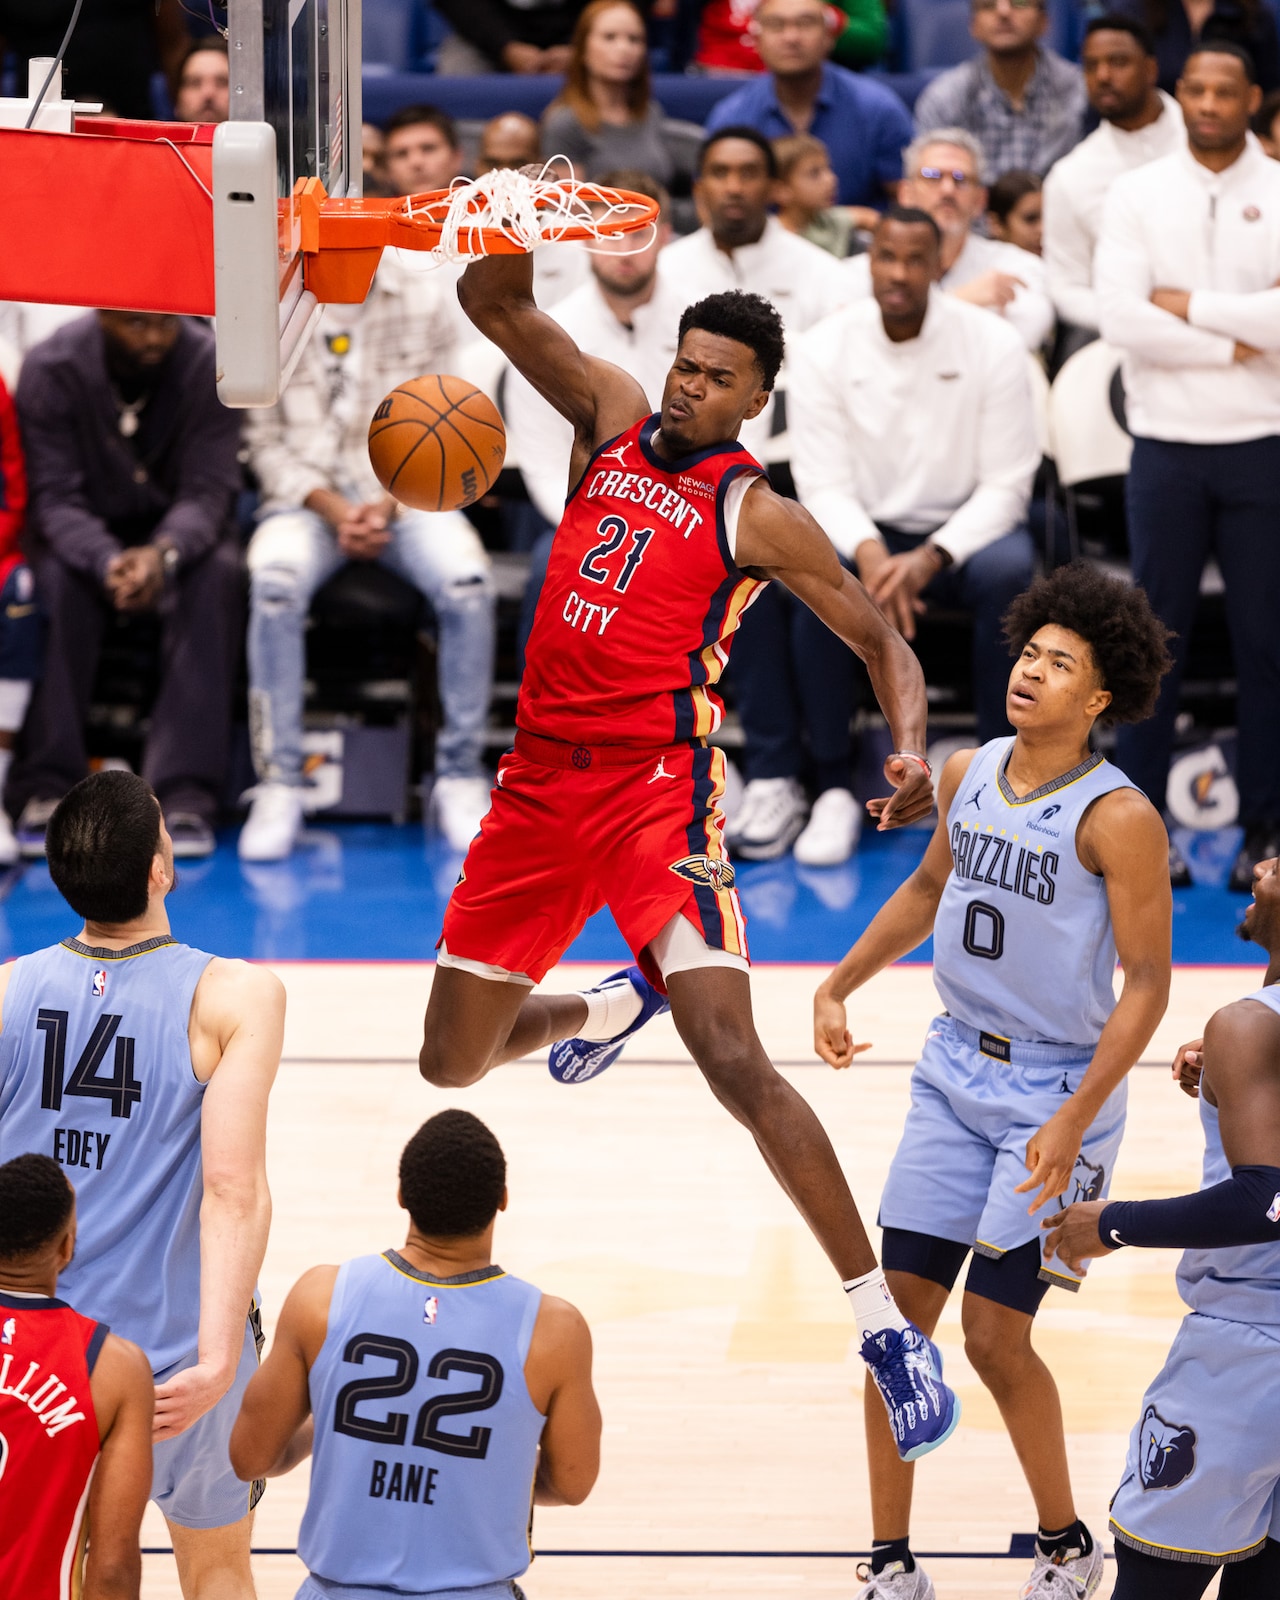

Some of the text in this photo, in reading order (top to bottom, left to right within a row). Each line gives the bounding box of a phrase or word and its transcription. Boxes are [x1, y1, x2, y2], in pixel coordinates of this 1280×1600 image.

[586, 470, 703, 539] CRESCENT
[677, 485, 715, 501] PRODUCTS
[678, 475, 715, 494] NEWAGE
[579, 514, 656, 594] 21
[562, 591, 619, 636] CITY
[1026, 820, 1060, 838] Robinhood
[952, 821, 1059, 905] GRIZZLIES
[963, 899, 1005, 960] 0
[36, 1008, 142, 1119] 14
[53, 1128, 111, 1170] EDEY
[0, 1353, 86, 1438] LLUM
[333, 1332, 504, 1460] 22
[369, 1459, 439, 1505] BANE
